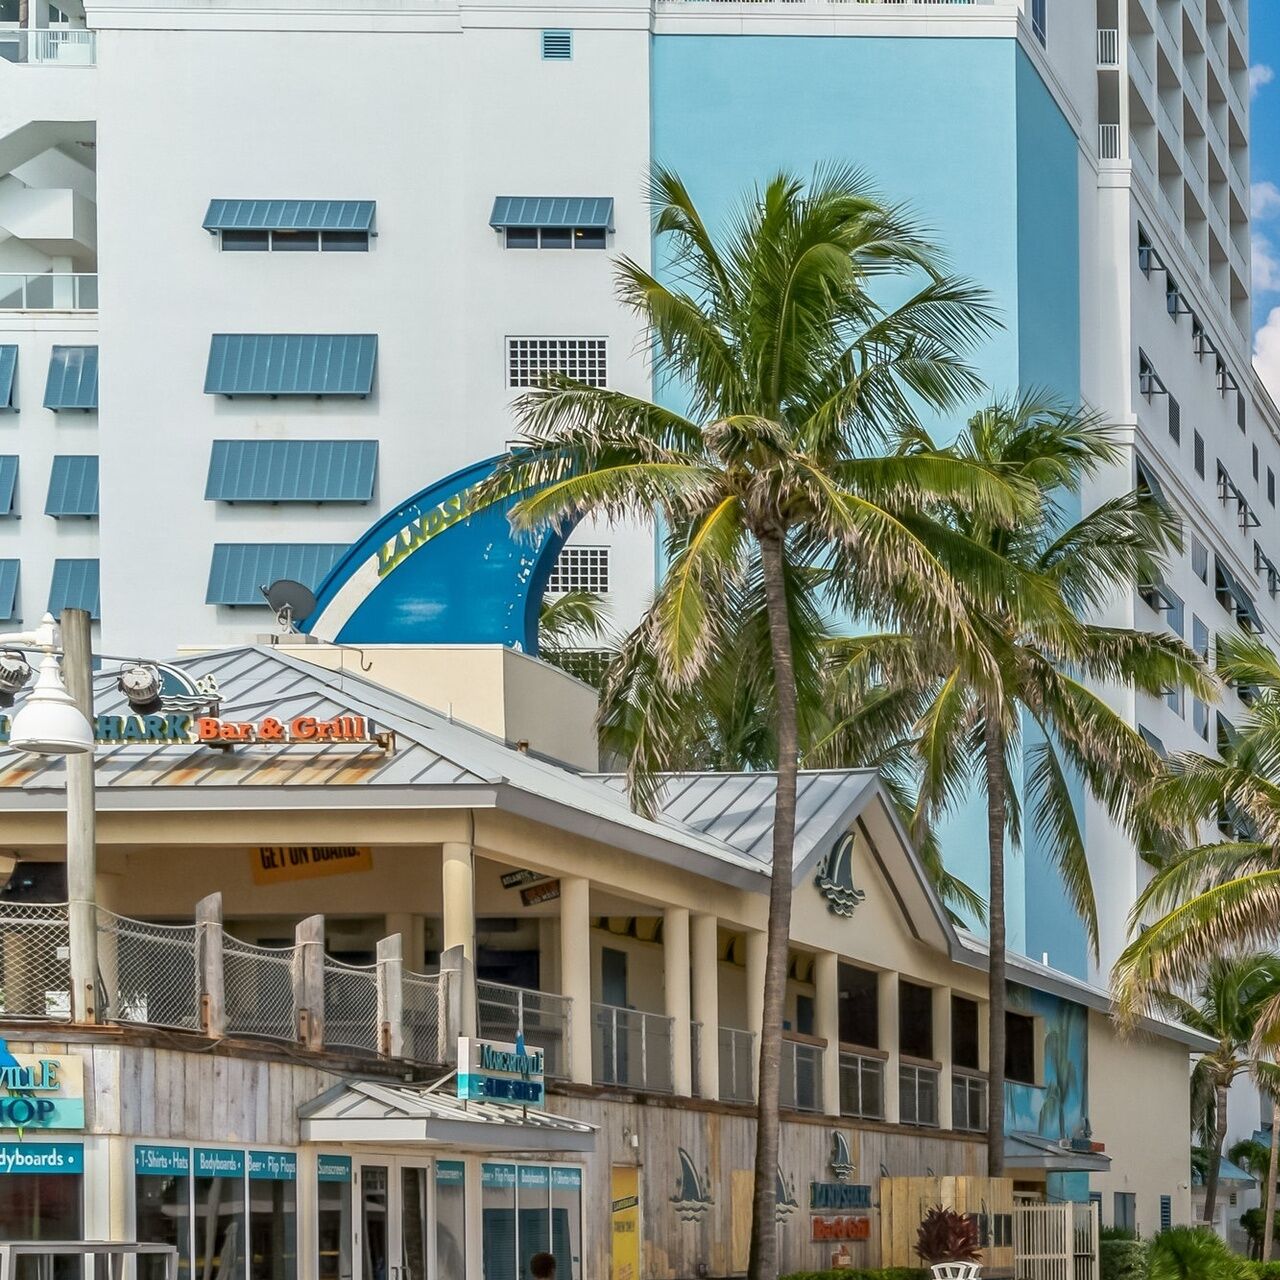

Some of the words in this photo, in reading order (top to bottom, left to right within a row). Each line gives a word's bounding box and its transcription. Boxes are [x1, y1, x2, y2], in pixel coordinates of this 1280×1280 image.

[198, 717, 252, 740] Bar
[259, 717, 283, 739] &
[291, 716, 365, 740] Grill
[260, 847, 286, 869] GET
[140, 1151, 167, 1168] T-Shirts
[173, 1155, 188, 1168] Hats
[200, 1153, 237, 1176] Bodyboards
[267, 1156, 279, 1177] Flip
[318, 1158, 345, 1175] Sunscreen
